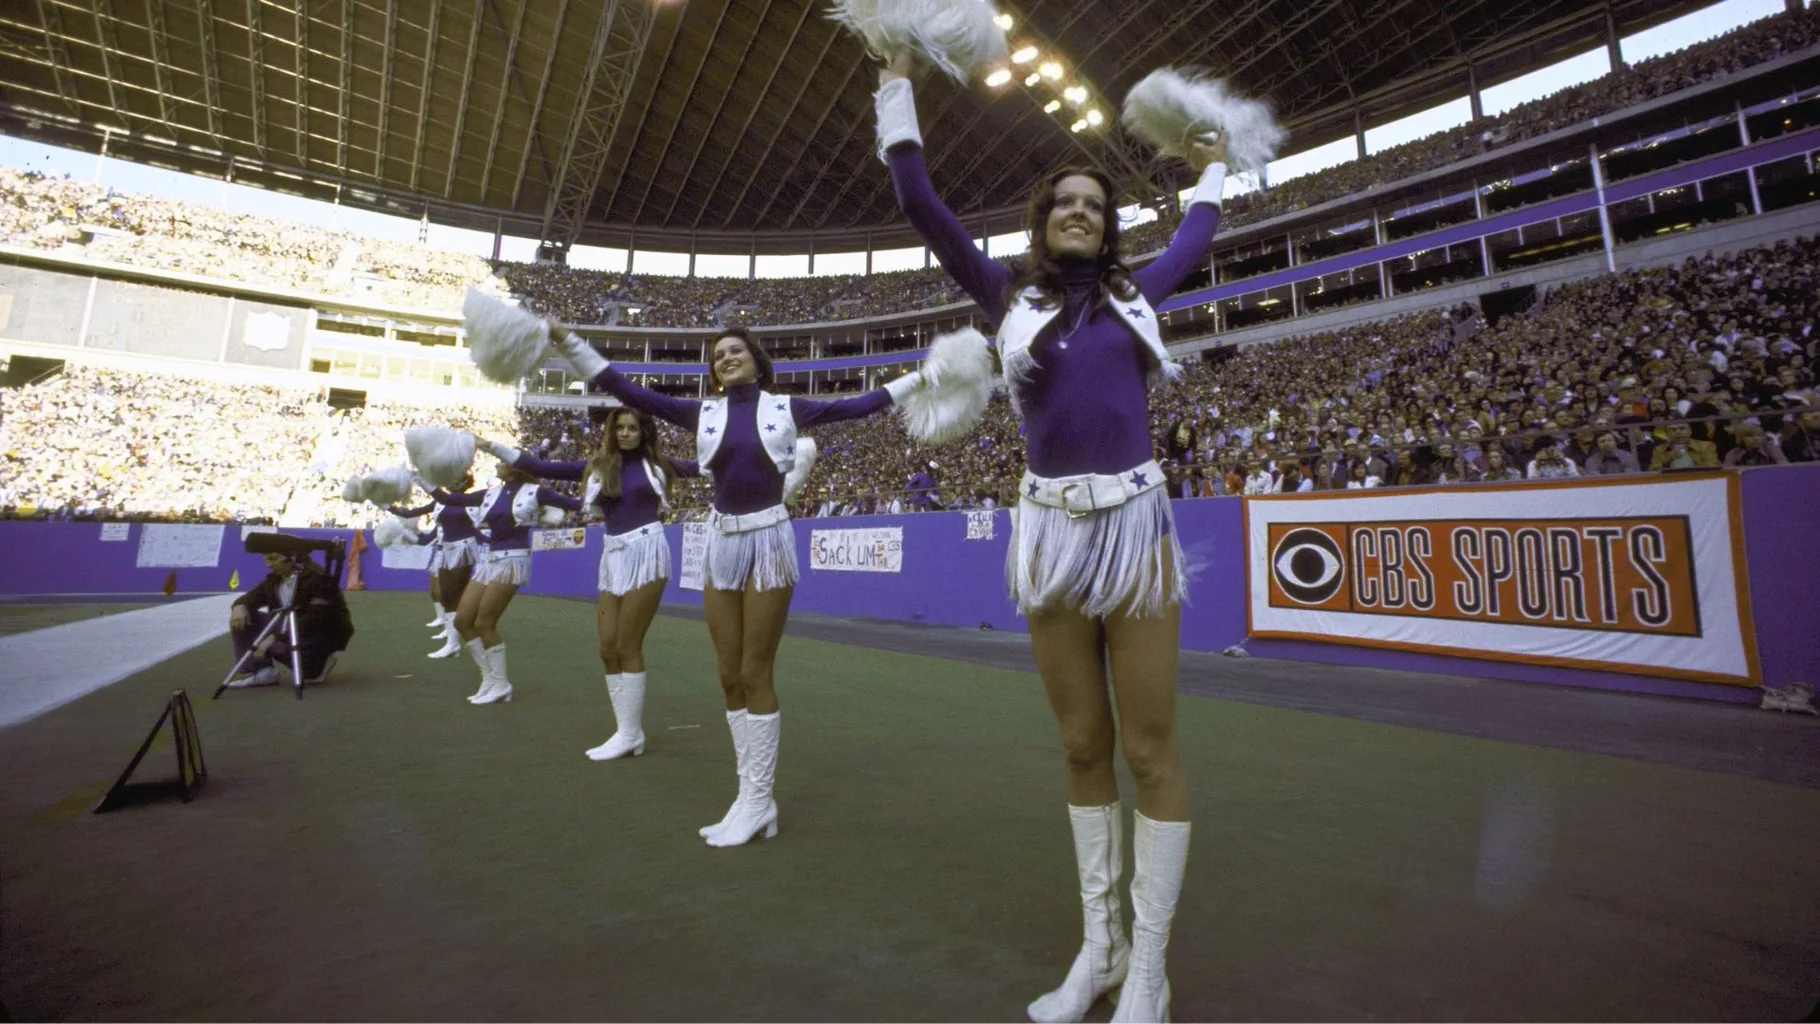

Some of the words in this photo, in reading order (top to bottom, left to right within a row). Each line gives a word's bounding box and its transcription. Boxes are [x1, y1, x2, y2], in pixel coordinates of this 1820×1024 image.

[857, 544, 876, 567] UM
[1353, 527, 1436, 609] CBS
[1451, 525, 1670, 625] SPORTS
